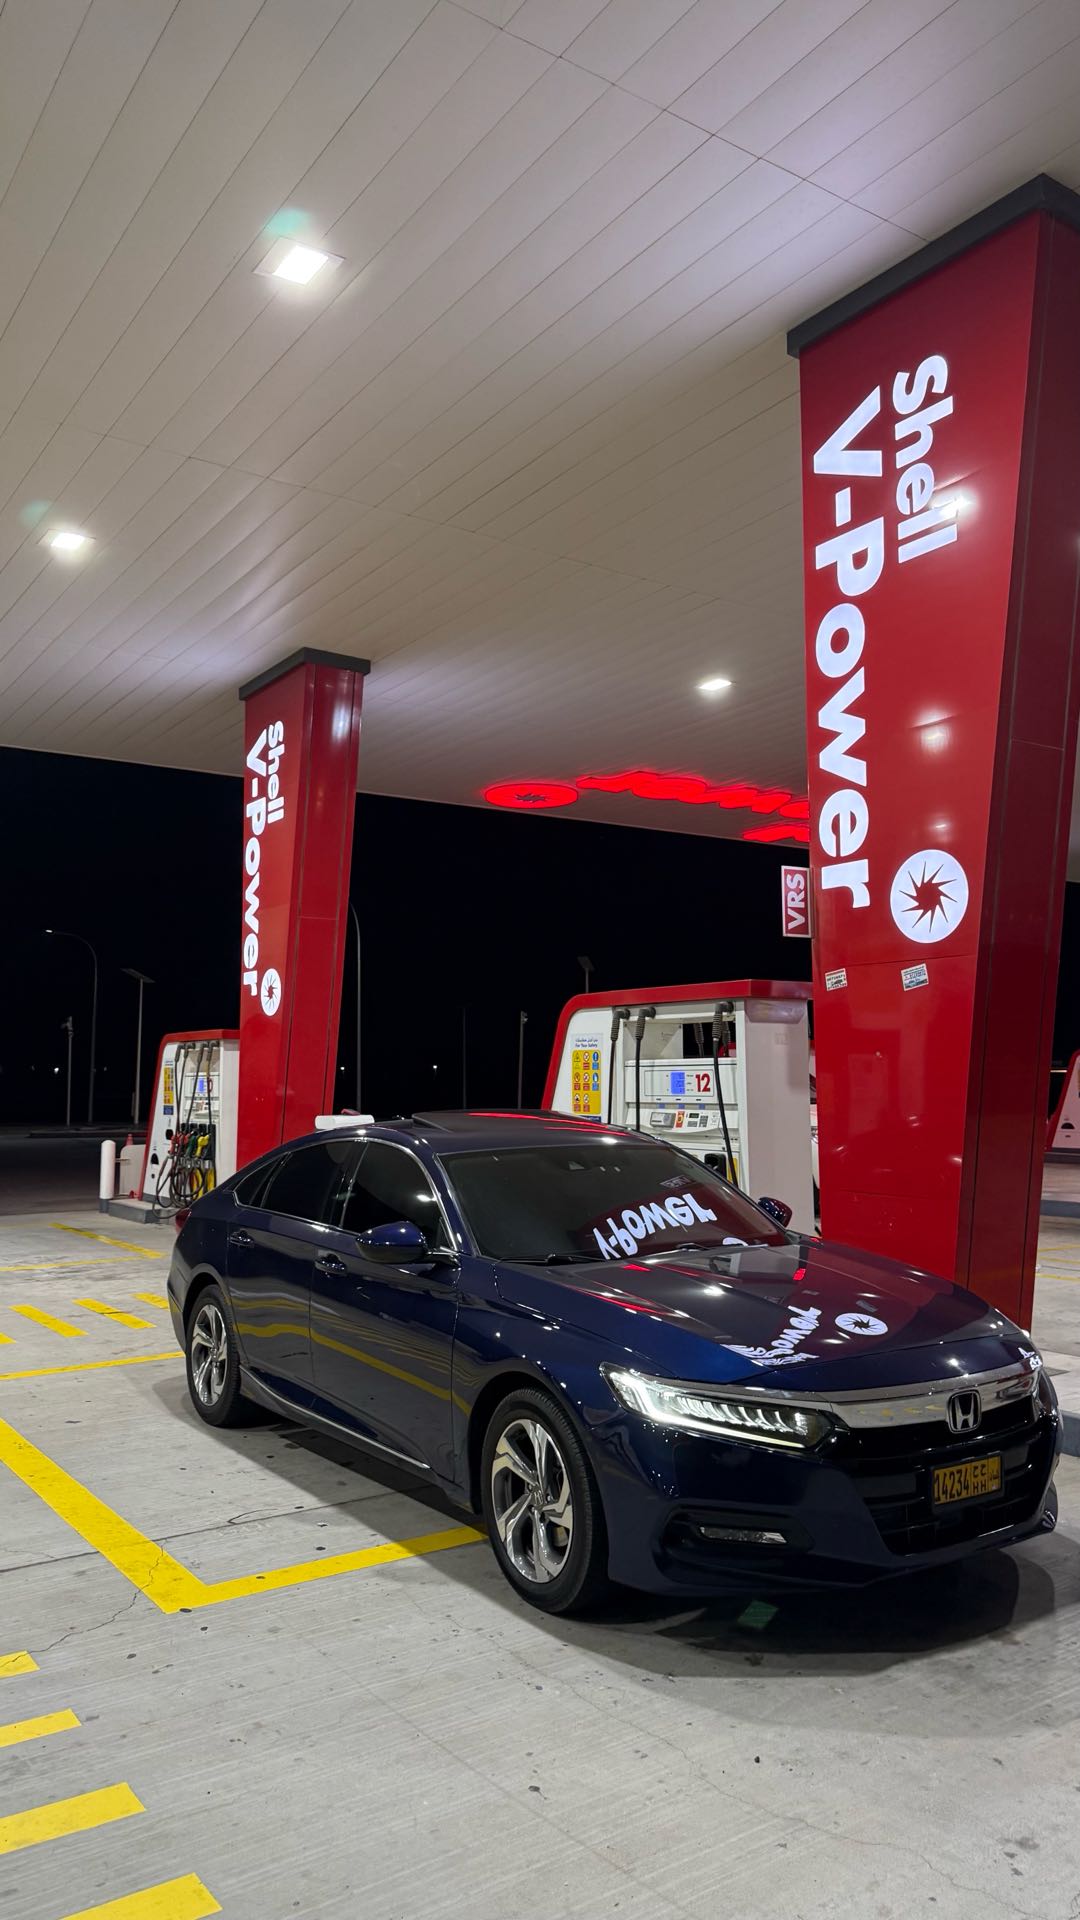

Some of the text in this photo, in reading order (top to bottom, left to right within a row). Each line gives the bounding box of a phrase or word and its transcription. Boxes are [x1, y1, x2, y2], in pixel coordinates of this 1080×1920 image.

[893, 355, 958, 563] Shell
[814, 386, 884, 909] V-Power
[267, 721, 285, 824] Shell
[243, 729, 267, 997] V-Power
[786, 873, 806, 930] VRS
[695, 1073, 711, 1093] 12
[935, 1467, 970, 1502] 14234
